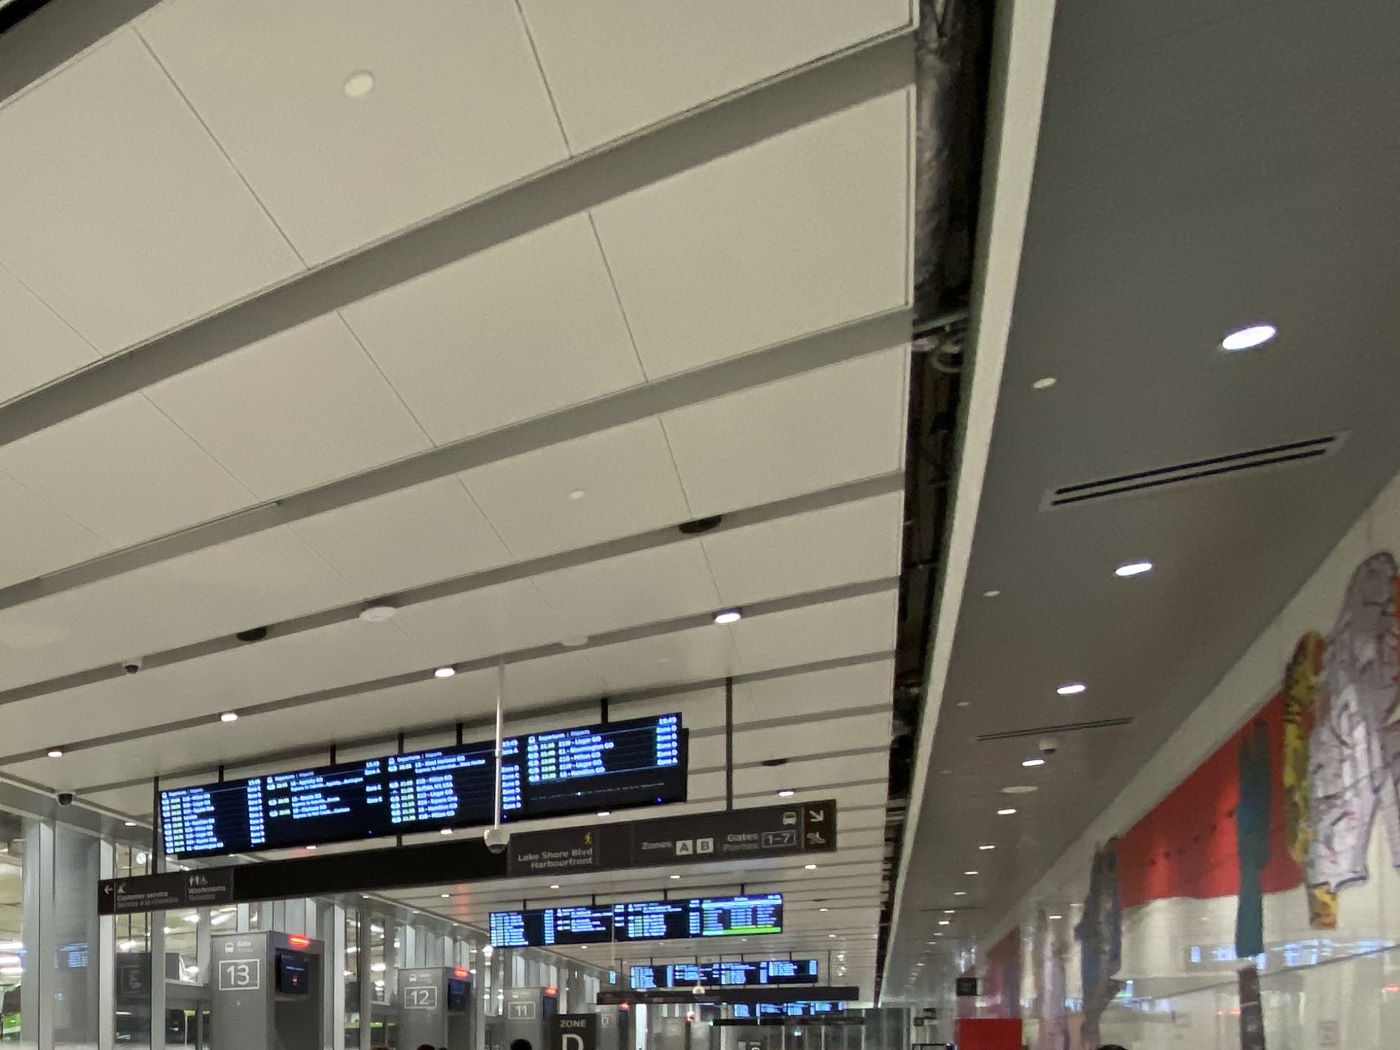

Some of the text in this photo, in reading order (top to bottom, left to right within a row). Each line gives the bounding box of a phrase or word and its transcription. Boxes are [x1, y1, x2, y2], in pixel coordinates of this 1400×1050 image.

[518, 847, 593, 862] Lake Shore Blvd
[531, 857, 593, 869] Harbourfront
[226, 964, 251, 986] 13
[411, 990, 430, 1006] 12
[515, 1004, 528, 1017] 11
[560, 1019, 587, 1029] ZONE
